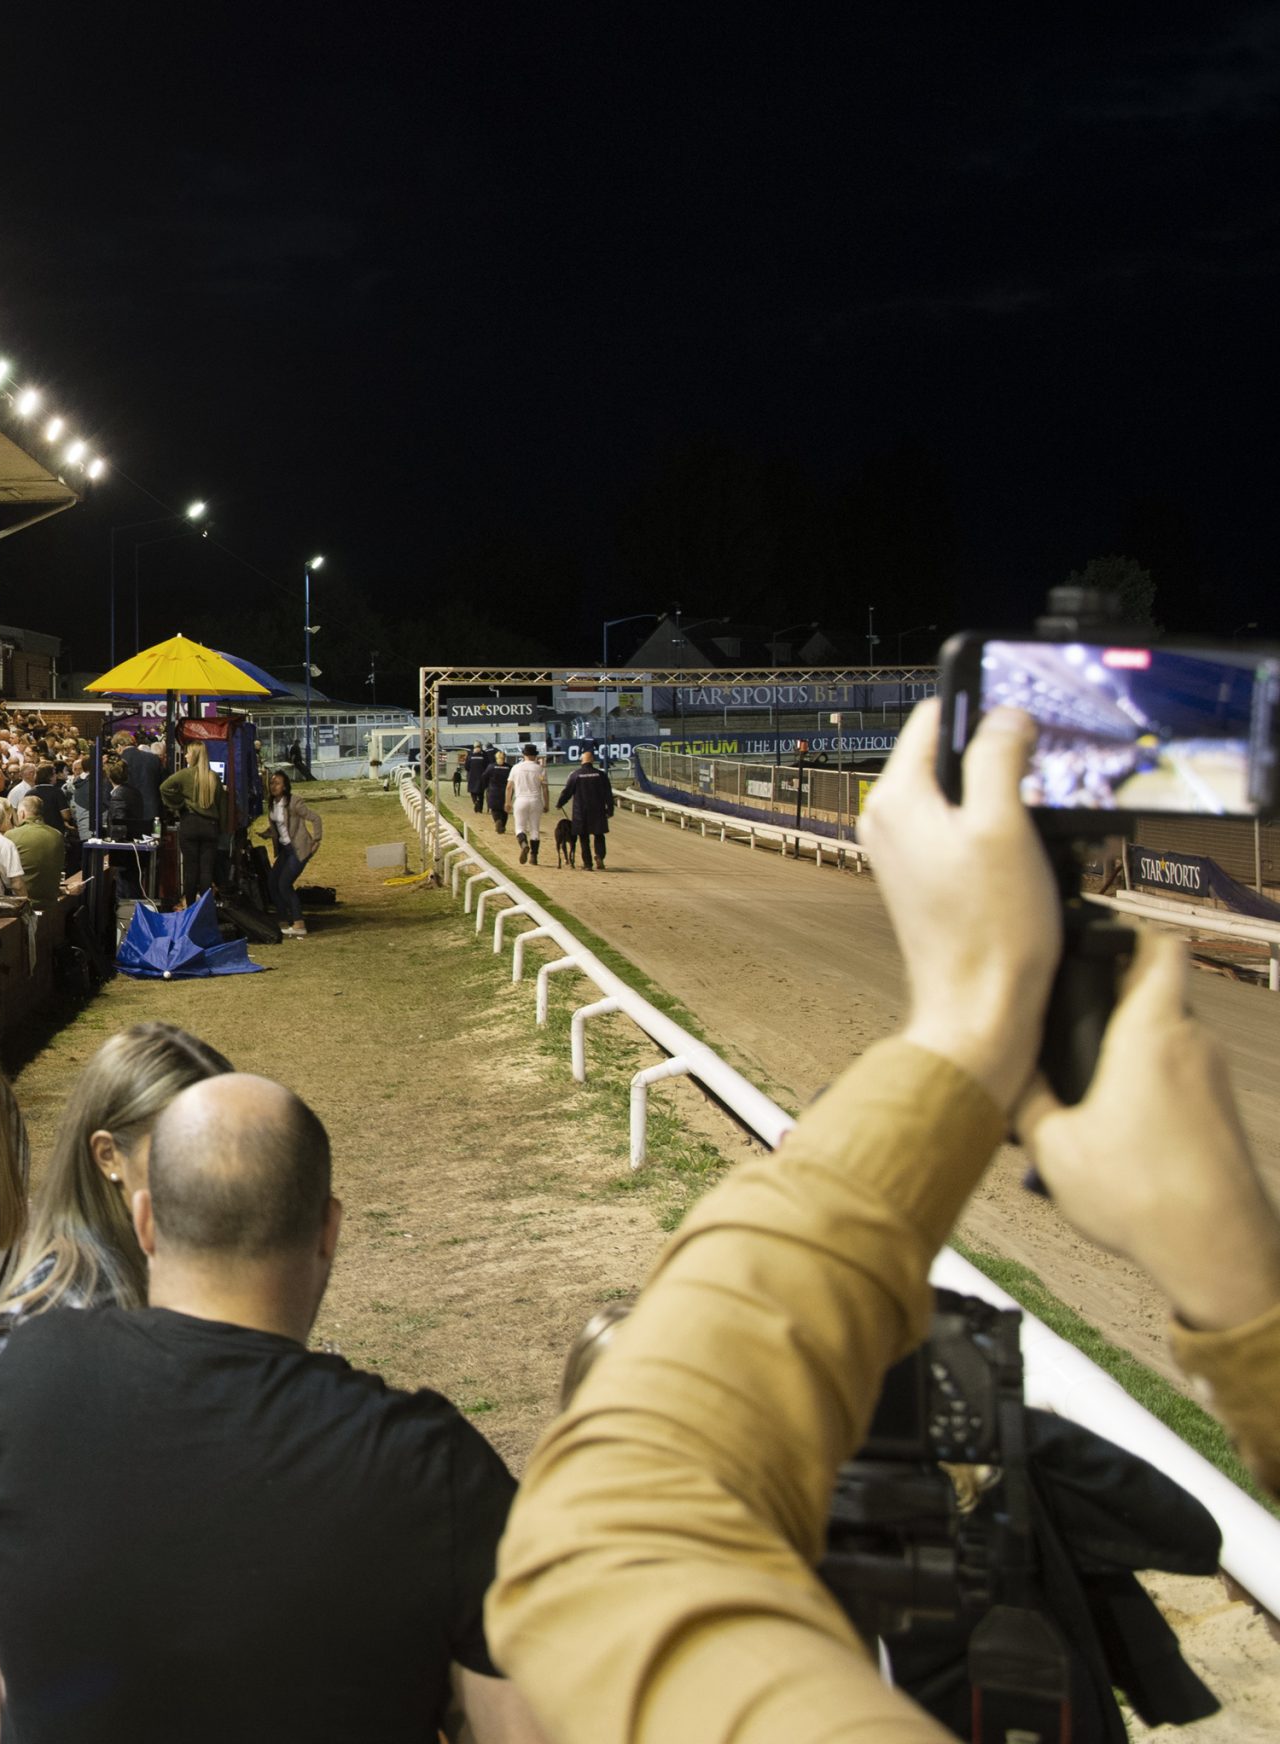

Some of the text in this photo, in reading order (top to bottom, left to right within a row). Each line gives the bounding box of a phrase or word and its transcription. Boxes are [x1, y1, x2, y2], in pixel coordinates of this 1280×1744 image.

[676, 686, 725, 705] STAR
[907, 682, 938, 700] TH
[452, 704, 533, 716] STAR SPORTS
[568, 740, 738, 760] OORD STADIUM
[746, 739, 770, 753] THE
[813, 737, 828, 750] OF
[1141, 857, 1201, 889] STAR SPORTS
